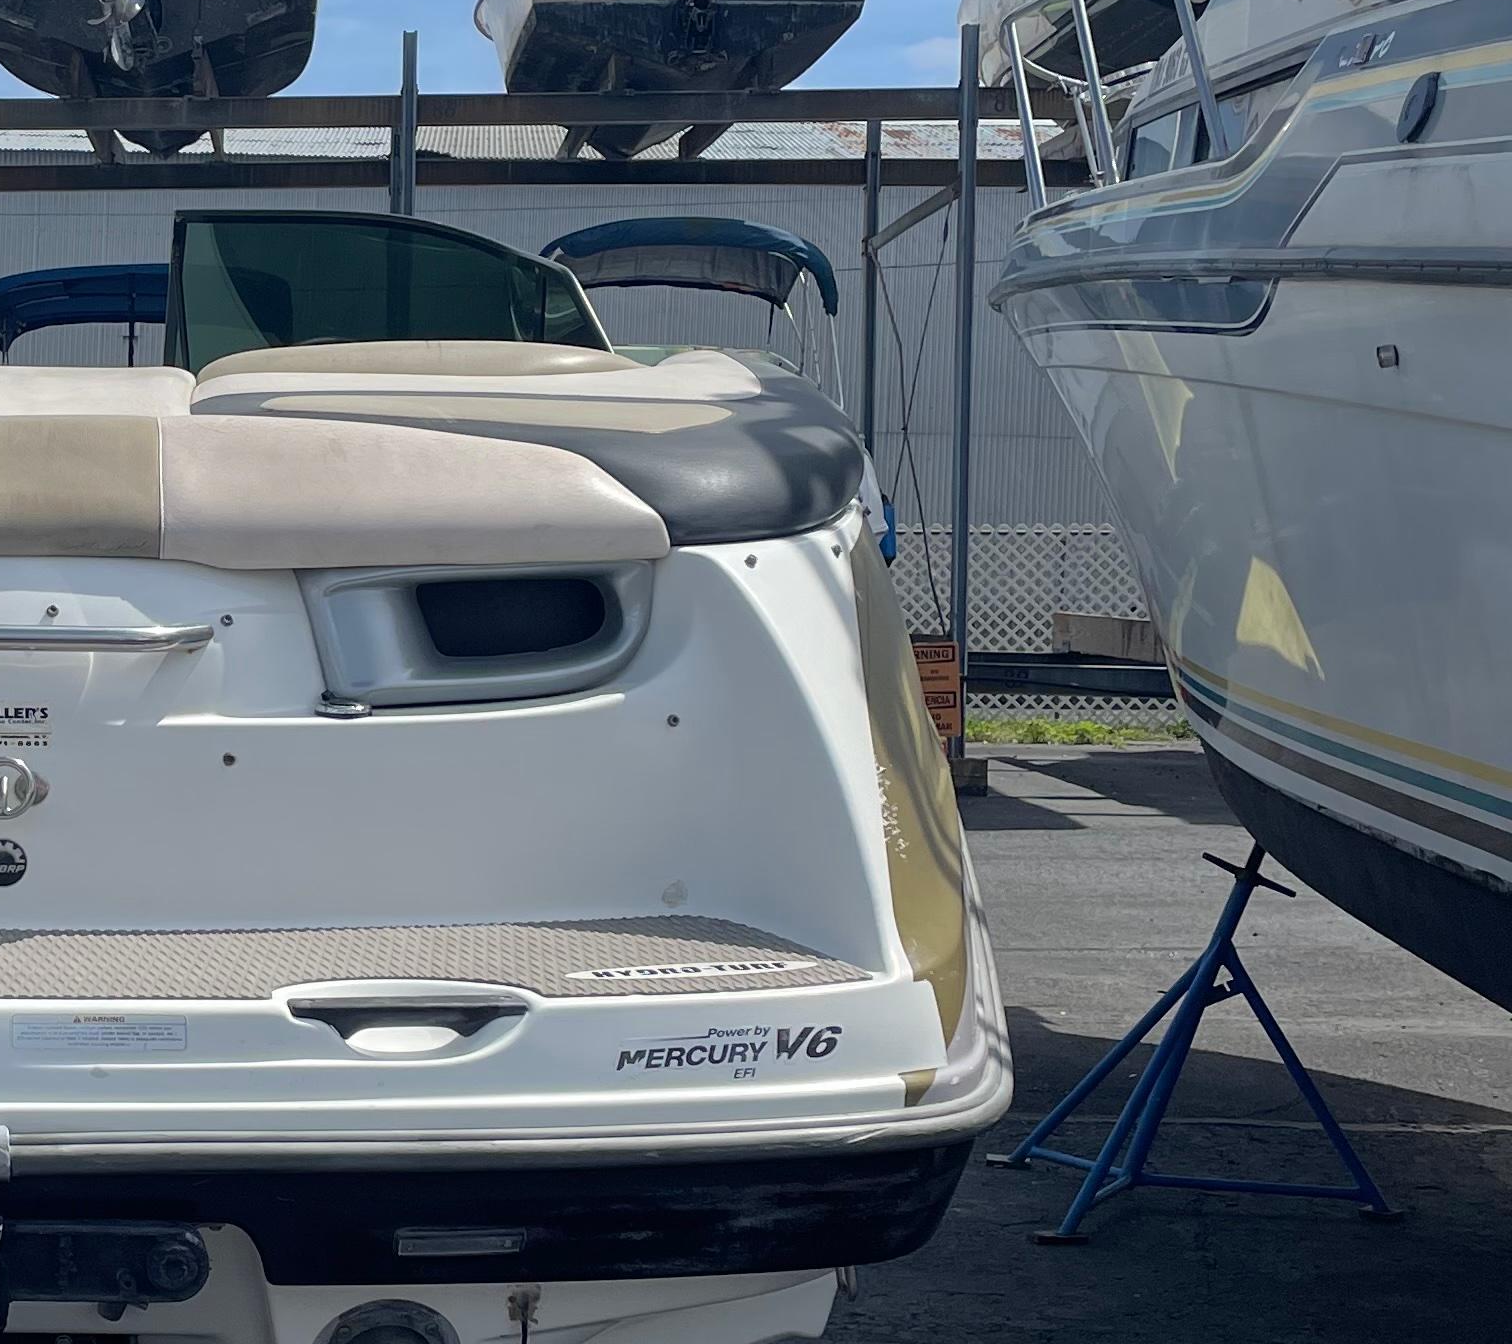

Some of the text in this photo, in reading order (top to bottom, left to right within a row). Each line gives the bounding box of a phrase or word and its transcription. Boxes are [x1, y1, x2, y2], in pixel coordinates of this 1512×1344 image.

[913, 648, 950, 660] RNING
[591, 960, 788, 978] HYDRO-TURF
[83, 1015, 126, 1023] WARNING
[707, 1026, 771, 1039] Power by
[776, 1026, 843, 1060] V6
[616, 1040, 768, 1071] MERCURY
[733, 1067, 756, 1079] EFI
